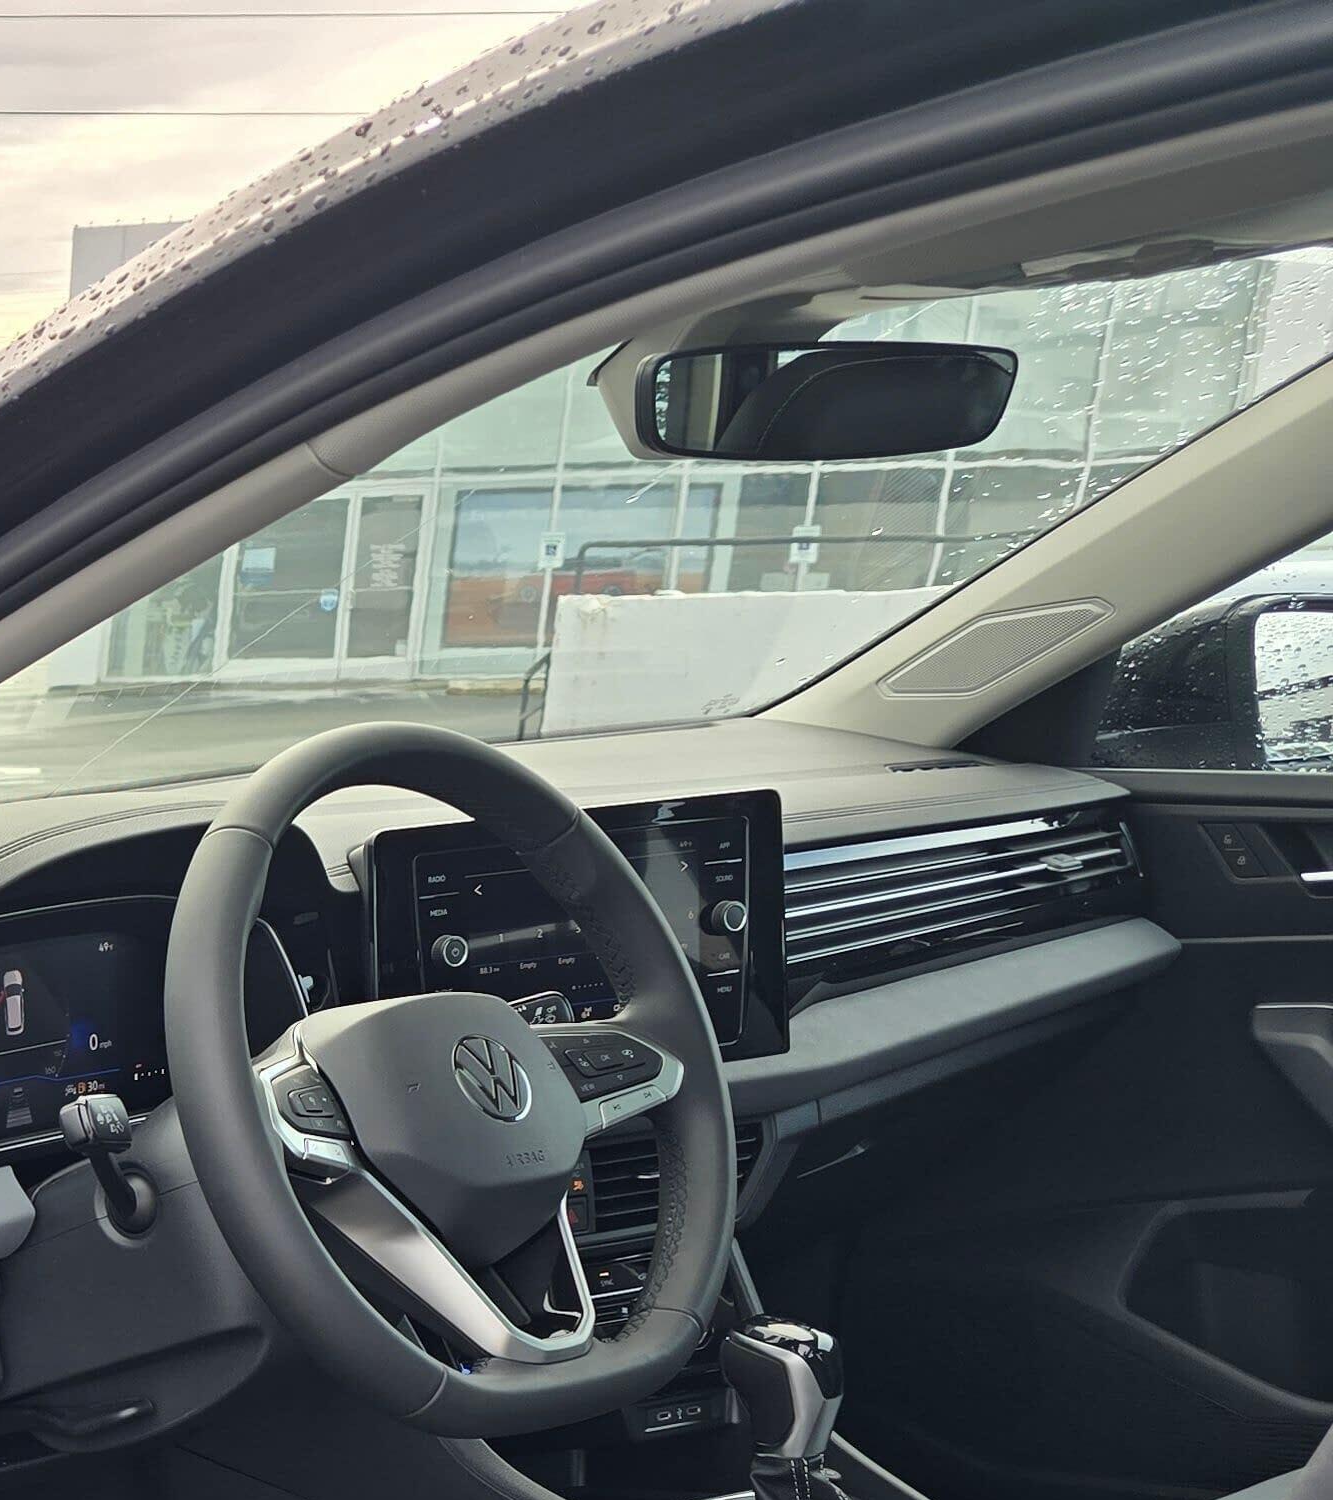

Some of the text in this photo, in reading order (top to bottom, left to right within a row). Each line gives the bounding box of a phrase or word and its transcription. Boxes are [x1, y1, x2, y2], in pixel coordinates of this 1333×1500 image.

[428, 874, 446, 883] RADIO
[715, 874, 734, 882] SOUND
[430, 908, 448, 918] MEDIA
[558, 957, 575, 965] Empty
[520, 962, 537, 970] Empty
[89, 1033, 99, 1051] 0
[87, 1080, 99, 1093] 30
[505, 1149, 546, 1168] AIRBAG
